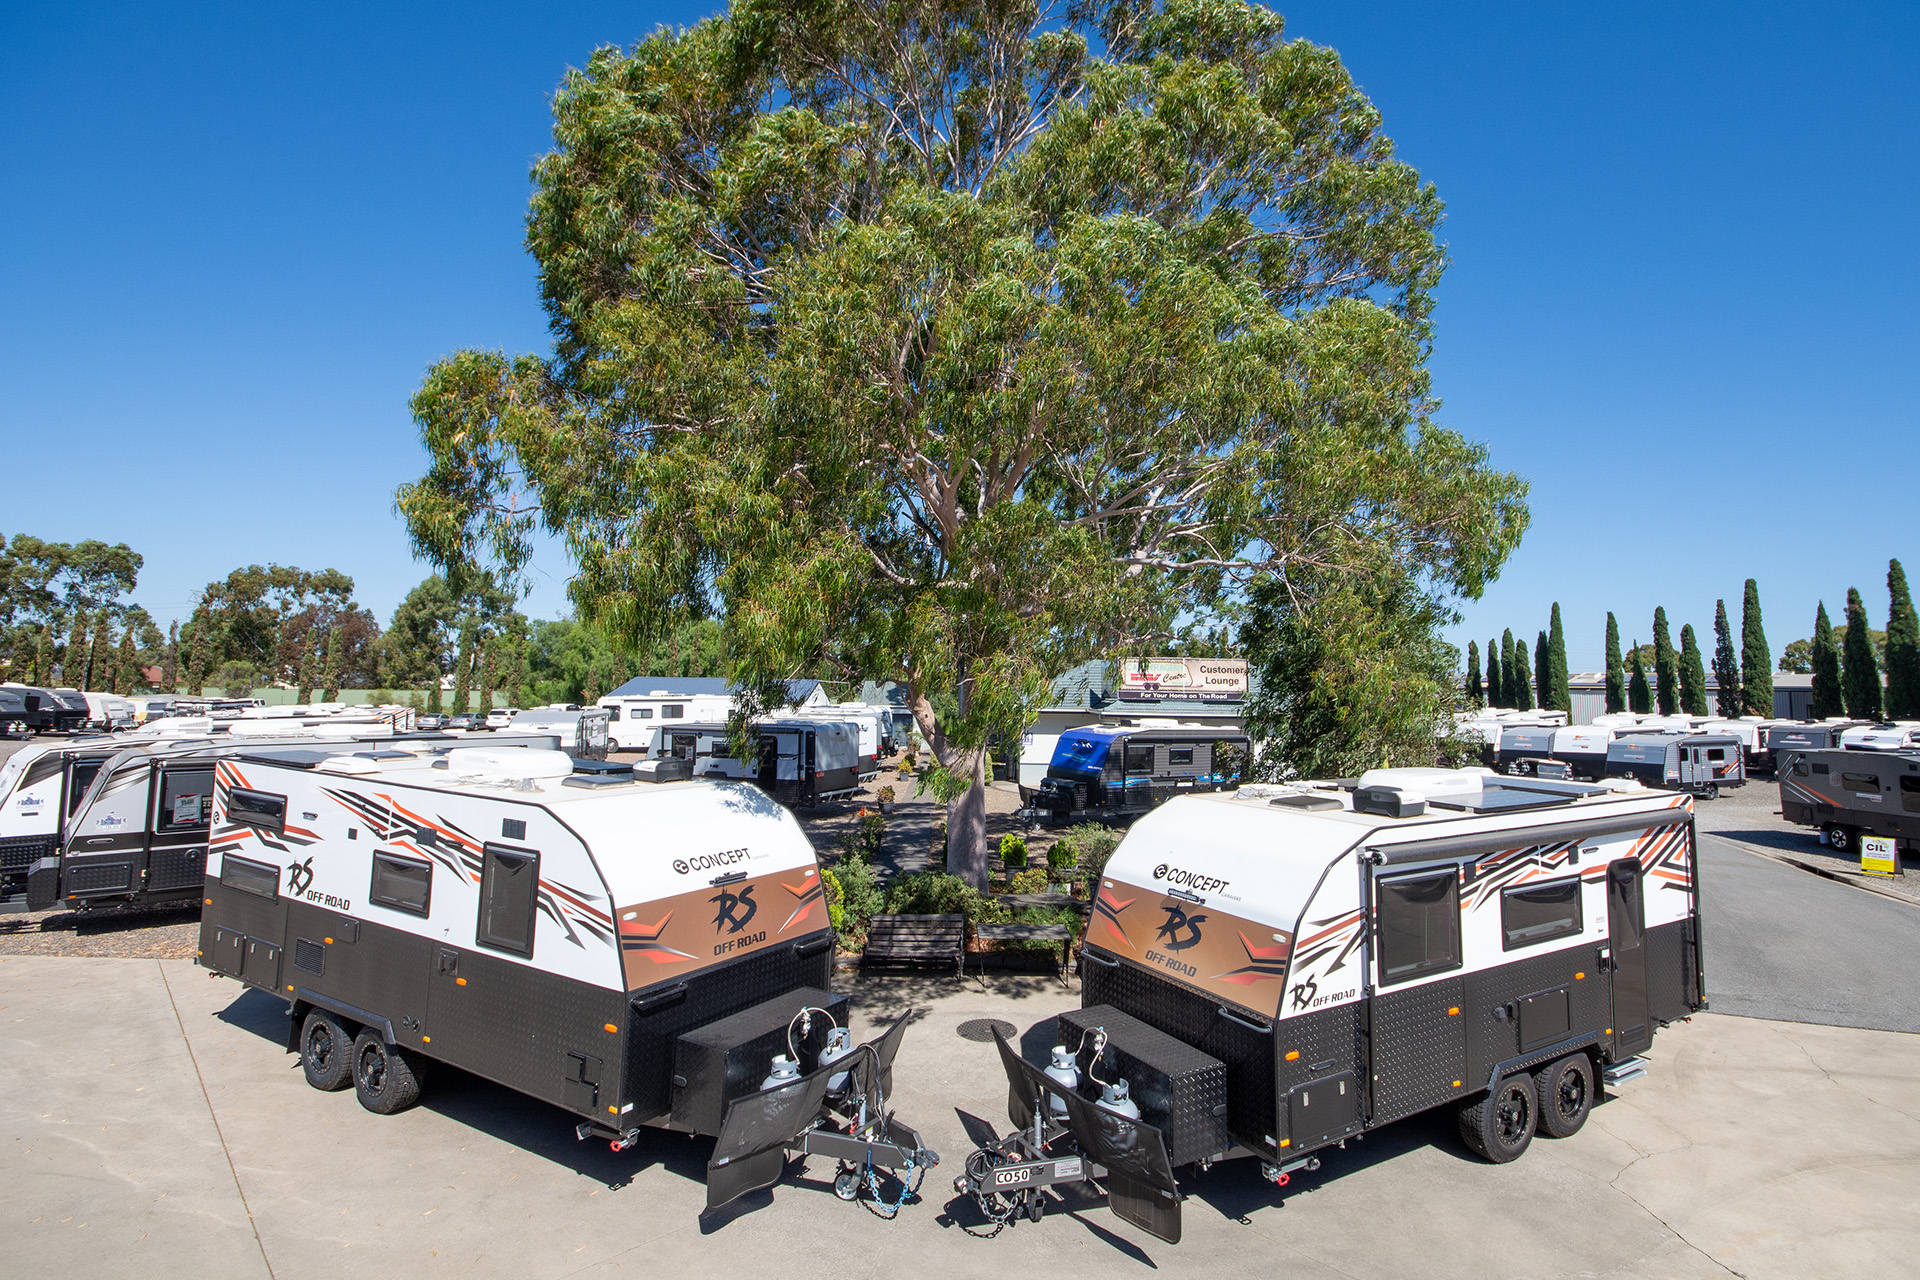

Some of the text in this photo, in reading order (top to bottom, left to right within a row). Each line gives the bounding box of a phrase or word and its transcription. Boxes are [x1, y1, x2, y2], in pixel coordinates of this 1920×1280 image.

[1200, 665, 1245, 674] Customer
[1205, 676, 1240, 686] Lounge
[689, 847, 751, 871] CONCEPT
[1866, 843, 1887, 852] CIL
[286, 856, 314, 897] RS
[1166, 867, 1230, 895] CONCEPT
[306, 889, 351, 911] OFF ROAD
[707, 885, 757, 935] RS
[1155, 900, 1209, 956] RS
[713, 931, 767, 956] OFF ROAD
[1145, 949, 1197, 978] OFF ROAD
[1288, 972, 1318, 1012] RS
[1313, 988, 1356, 1007] OFF ROAD
